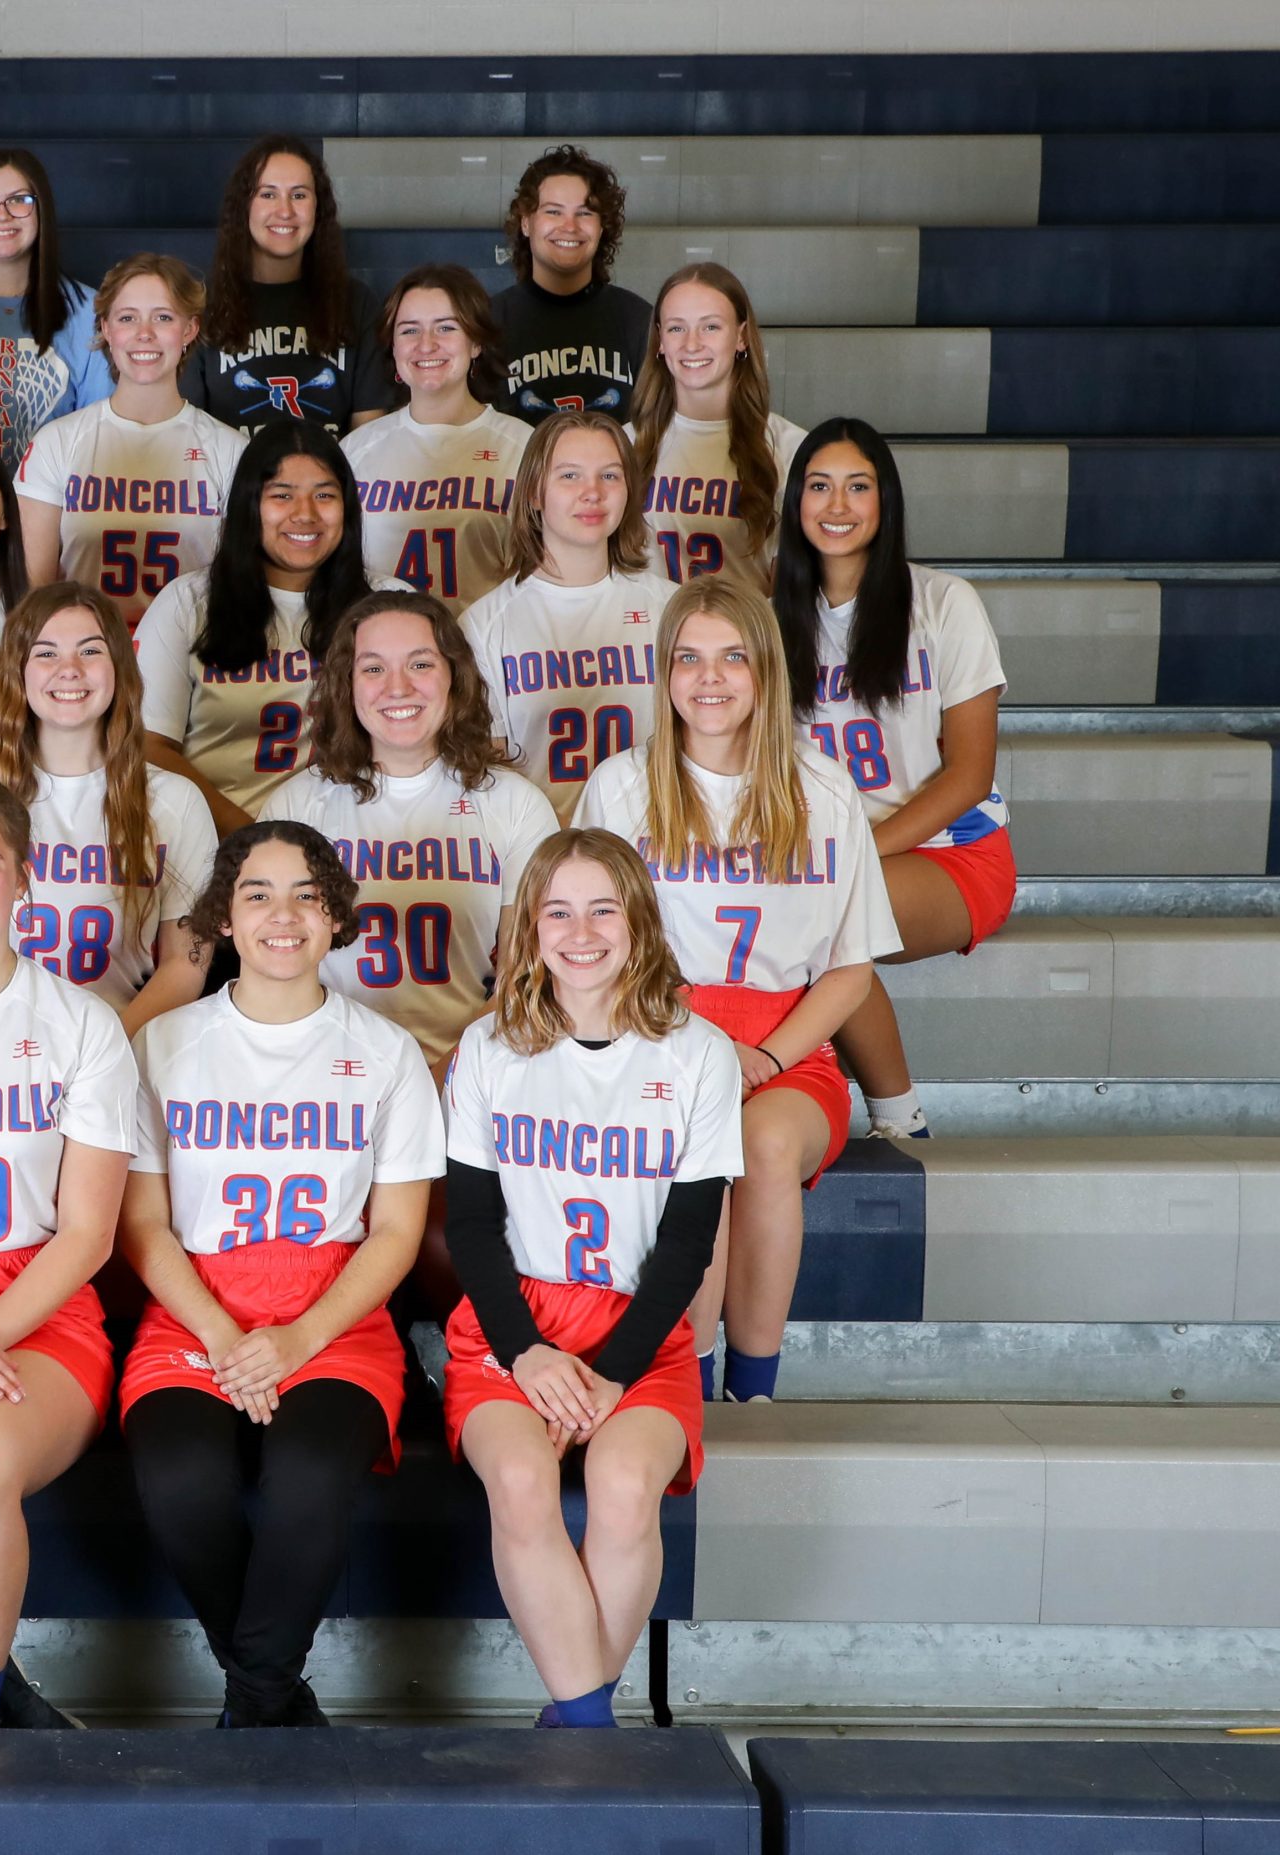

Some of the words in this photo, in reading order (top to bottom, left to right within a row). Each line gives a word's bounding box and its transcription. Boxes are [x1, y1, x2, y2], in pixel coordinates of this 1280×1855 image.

[65, 474, 221, 516] RONCALL
[642, 476, 746, 519] ONCAL
[100, 529, 180, 597] 55
[394, 528, 458, 598] 41
[657, 531, 724, 585] 12
[502, 643, 655, 697] RONCAL
[254, 701, 318, 773] 2
[548, 704, 634, 783] 20
[810, 718, 892, 792] 18
[332, 836, 502, 886] ONCALLI
[16, 902, 115, 985] 28
[354, 901, 453, 988] 30
[715, 905, 762, 984] 7
[165, 1098, 369, 1151] RONCALL
[491, 1111, 680, 1179] RONCALL
[218, 1173, 328, 1252] 36
[562, 1197, 614, 1288] 2
